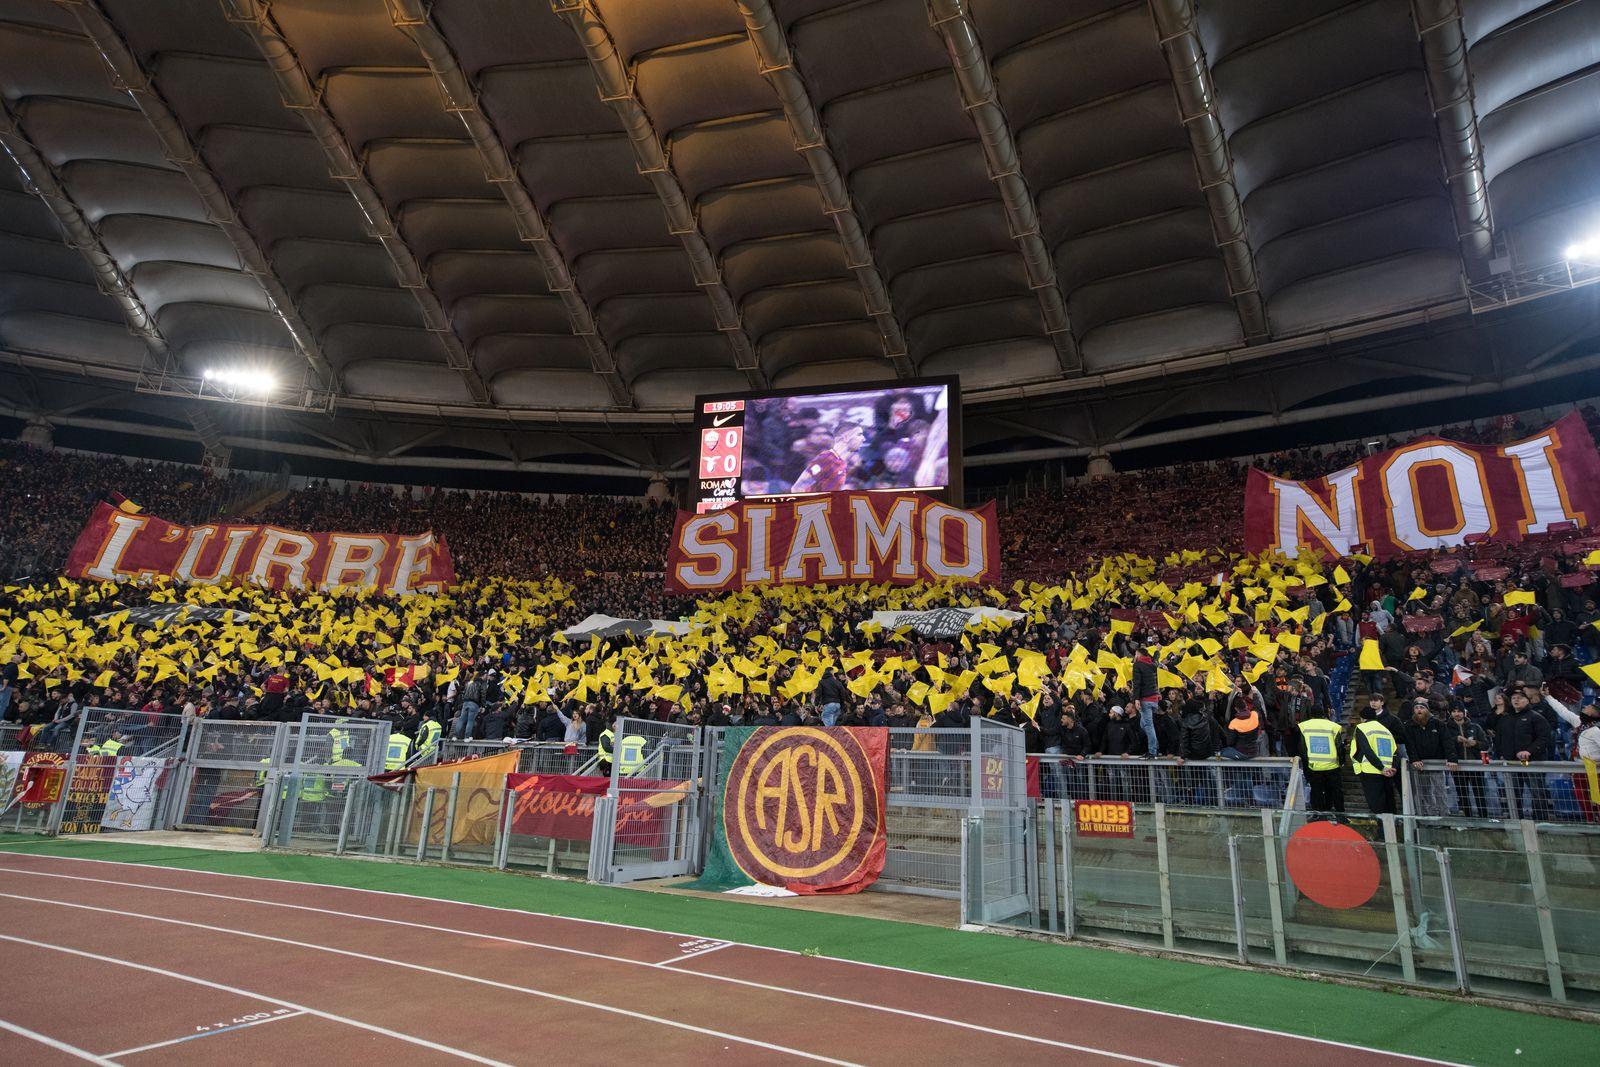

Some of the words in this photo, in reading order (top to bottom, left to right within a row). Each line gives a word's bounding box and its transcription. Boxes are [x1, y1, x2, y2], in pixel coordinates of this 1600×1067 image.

[725, 430, 738, 448] 0
[723, 454, 737, 472] 0
[701, 481, 726, 490] ROMA
[713, 486, 735, 497] Cares
[1269, 428, 1587, 559] NOI
[677, 496, 987, 589] SIAMO
[84, 511, 441, 596] L'URBE
[755, 744, 847, 853] ASR
[1080, 822, 1092, 831] DAI
